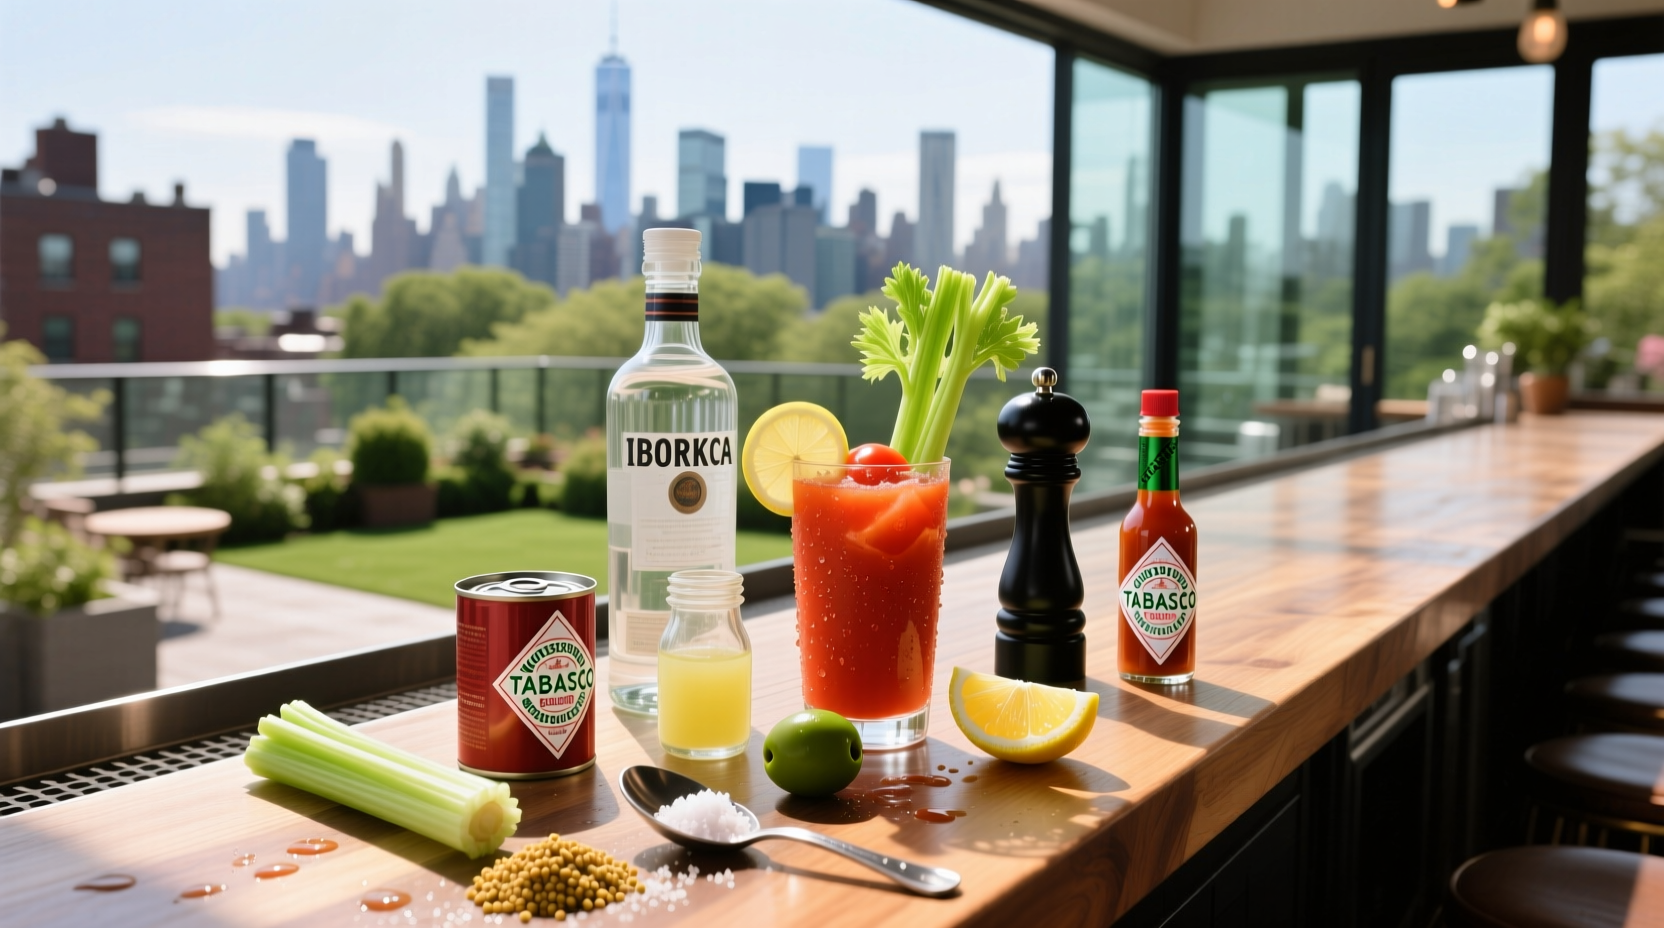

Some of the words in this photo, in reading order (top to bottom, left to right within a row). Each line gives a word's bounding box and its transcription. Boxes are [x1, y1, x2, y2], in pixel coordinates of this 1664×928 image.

[626, 436, 732, 467] IBORKCA
[1123, 590, 1196, 611] TABASCO
[509, 667, 594, 696] TABASCO
